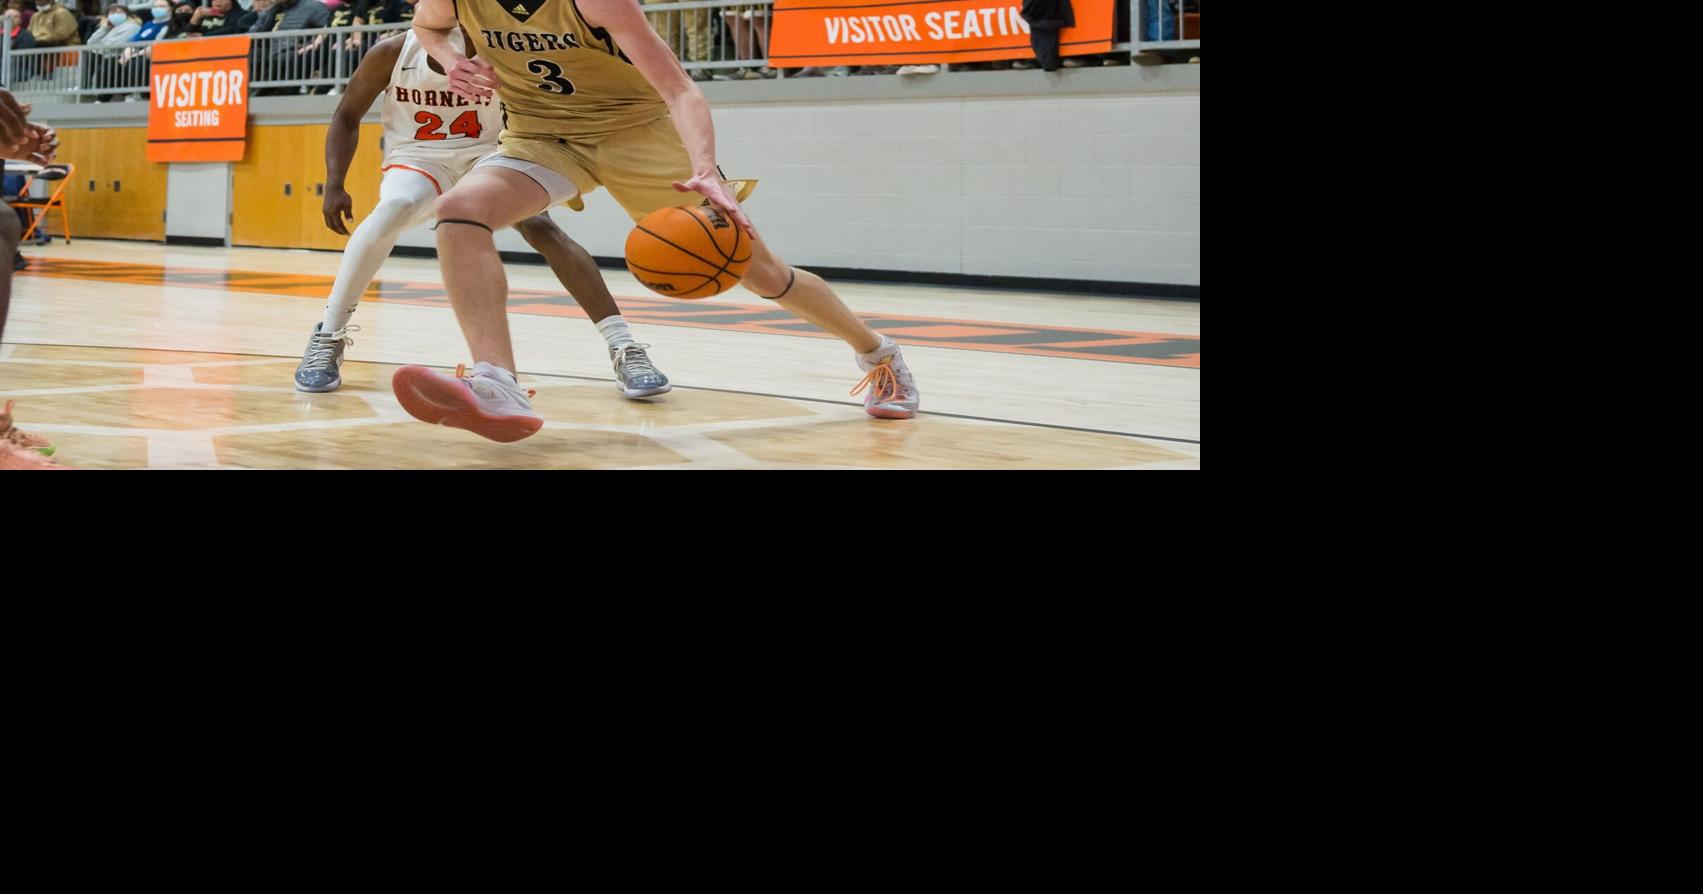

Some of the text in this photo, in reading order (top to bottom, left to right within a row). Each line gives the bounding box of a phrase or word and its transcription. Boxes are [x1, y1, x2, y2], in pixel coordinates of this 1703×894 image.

[480, 28, 580, 52] TIGERS
[824, 6, 1031, 44] VISITOR SEATIN
[154, 69, 244, 108] VISITOR
[526, 58, 576, 95] 3
[395, 86, 492, 107] HORNE
[174, 109, 219, 127] SEATING
[414, 110, 482, 140] 24
